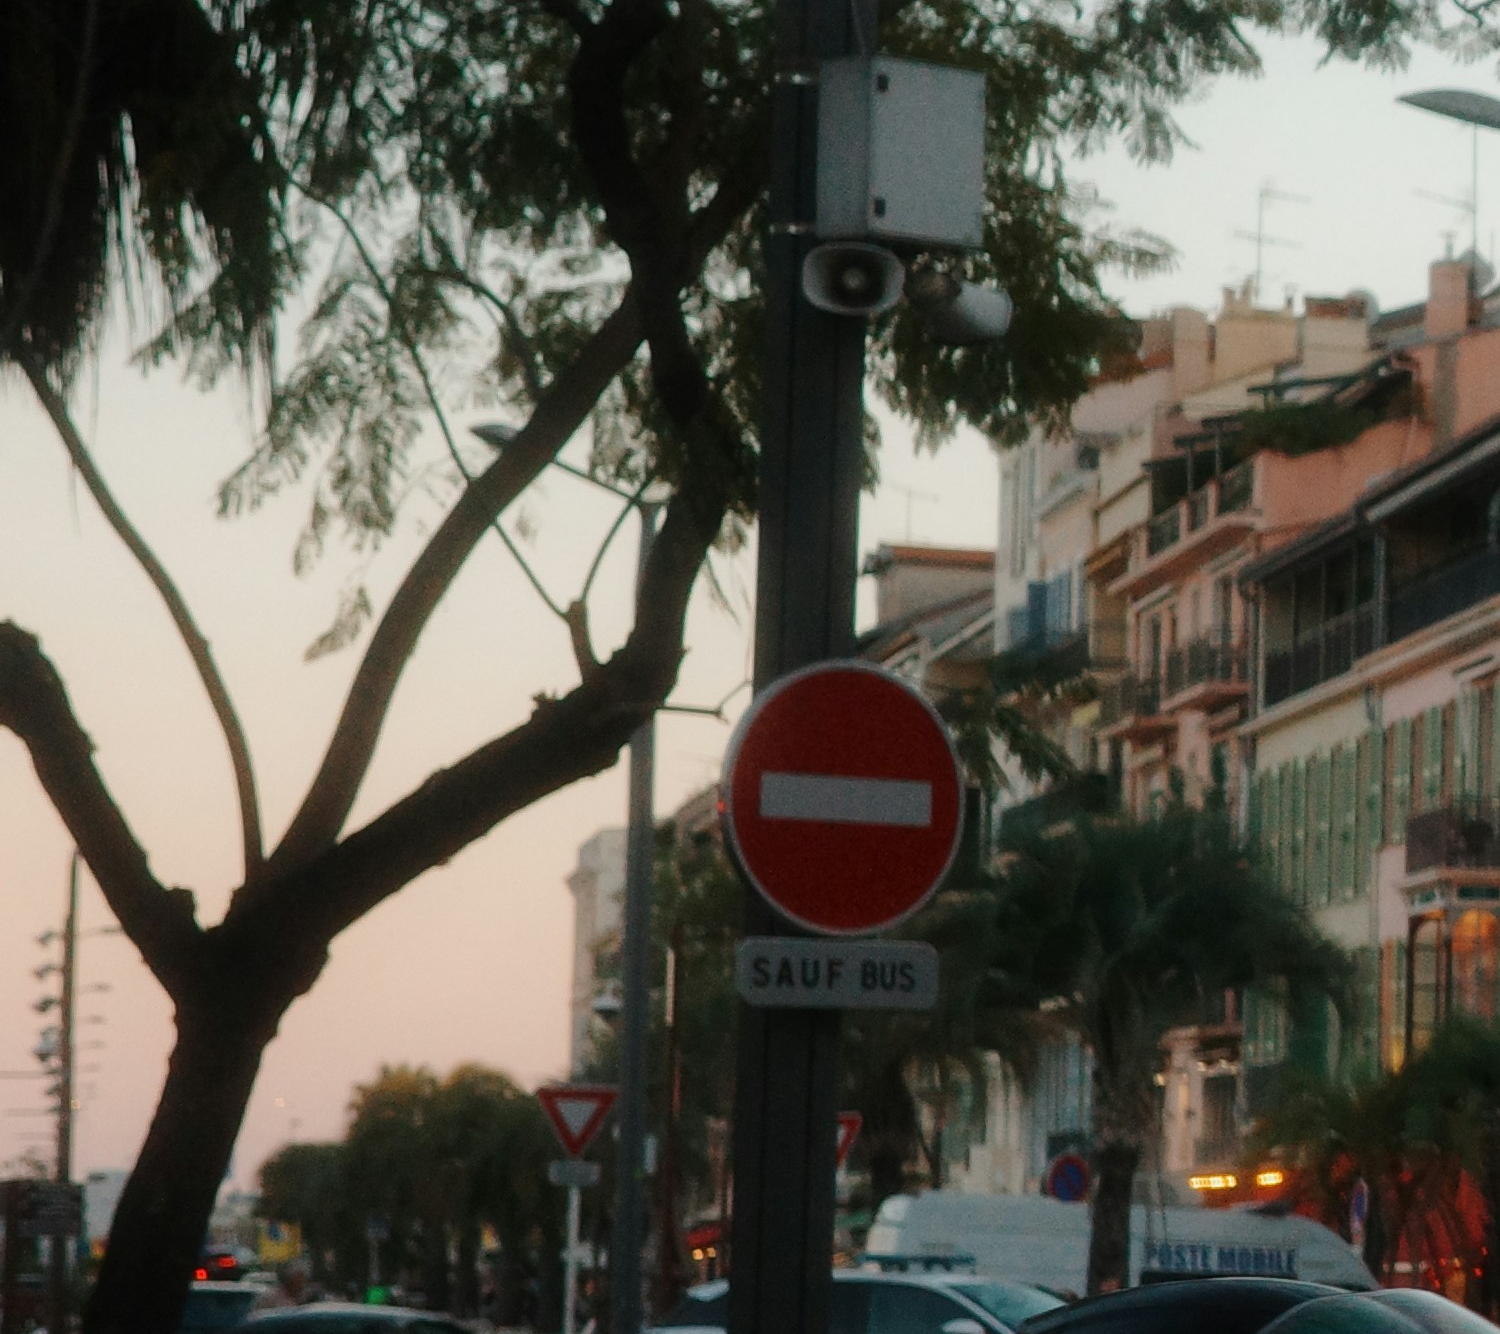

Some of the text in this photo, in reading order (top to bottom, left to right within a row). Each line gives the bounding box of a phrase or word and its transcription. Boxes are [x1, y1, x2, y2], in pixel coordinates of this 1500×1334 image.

[752, 956, 917, 992] SAUF BUS
[1217, 1246, 1296, 1274] MOBILE
